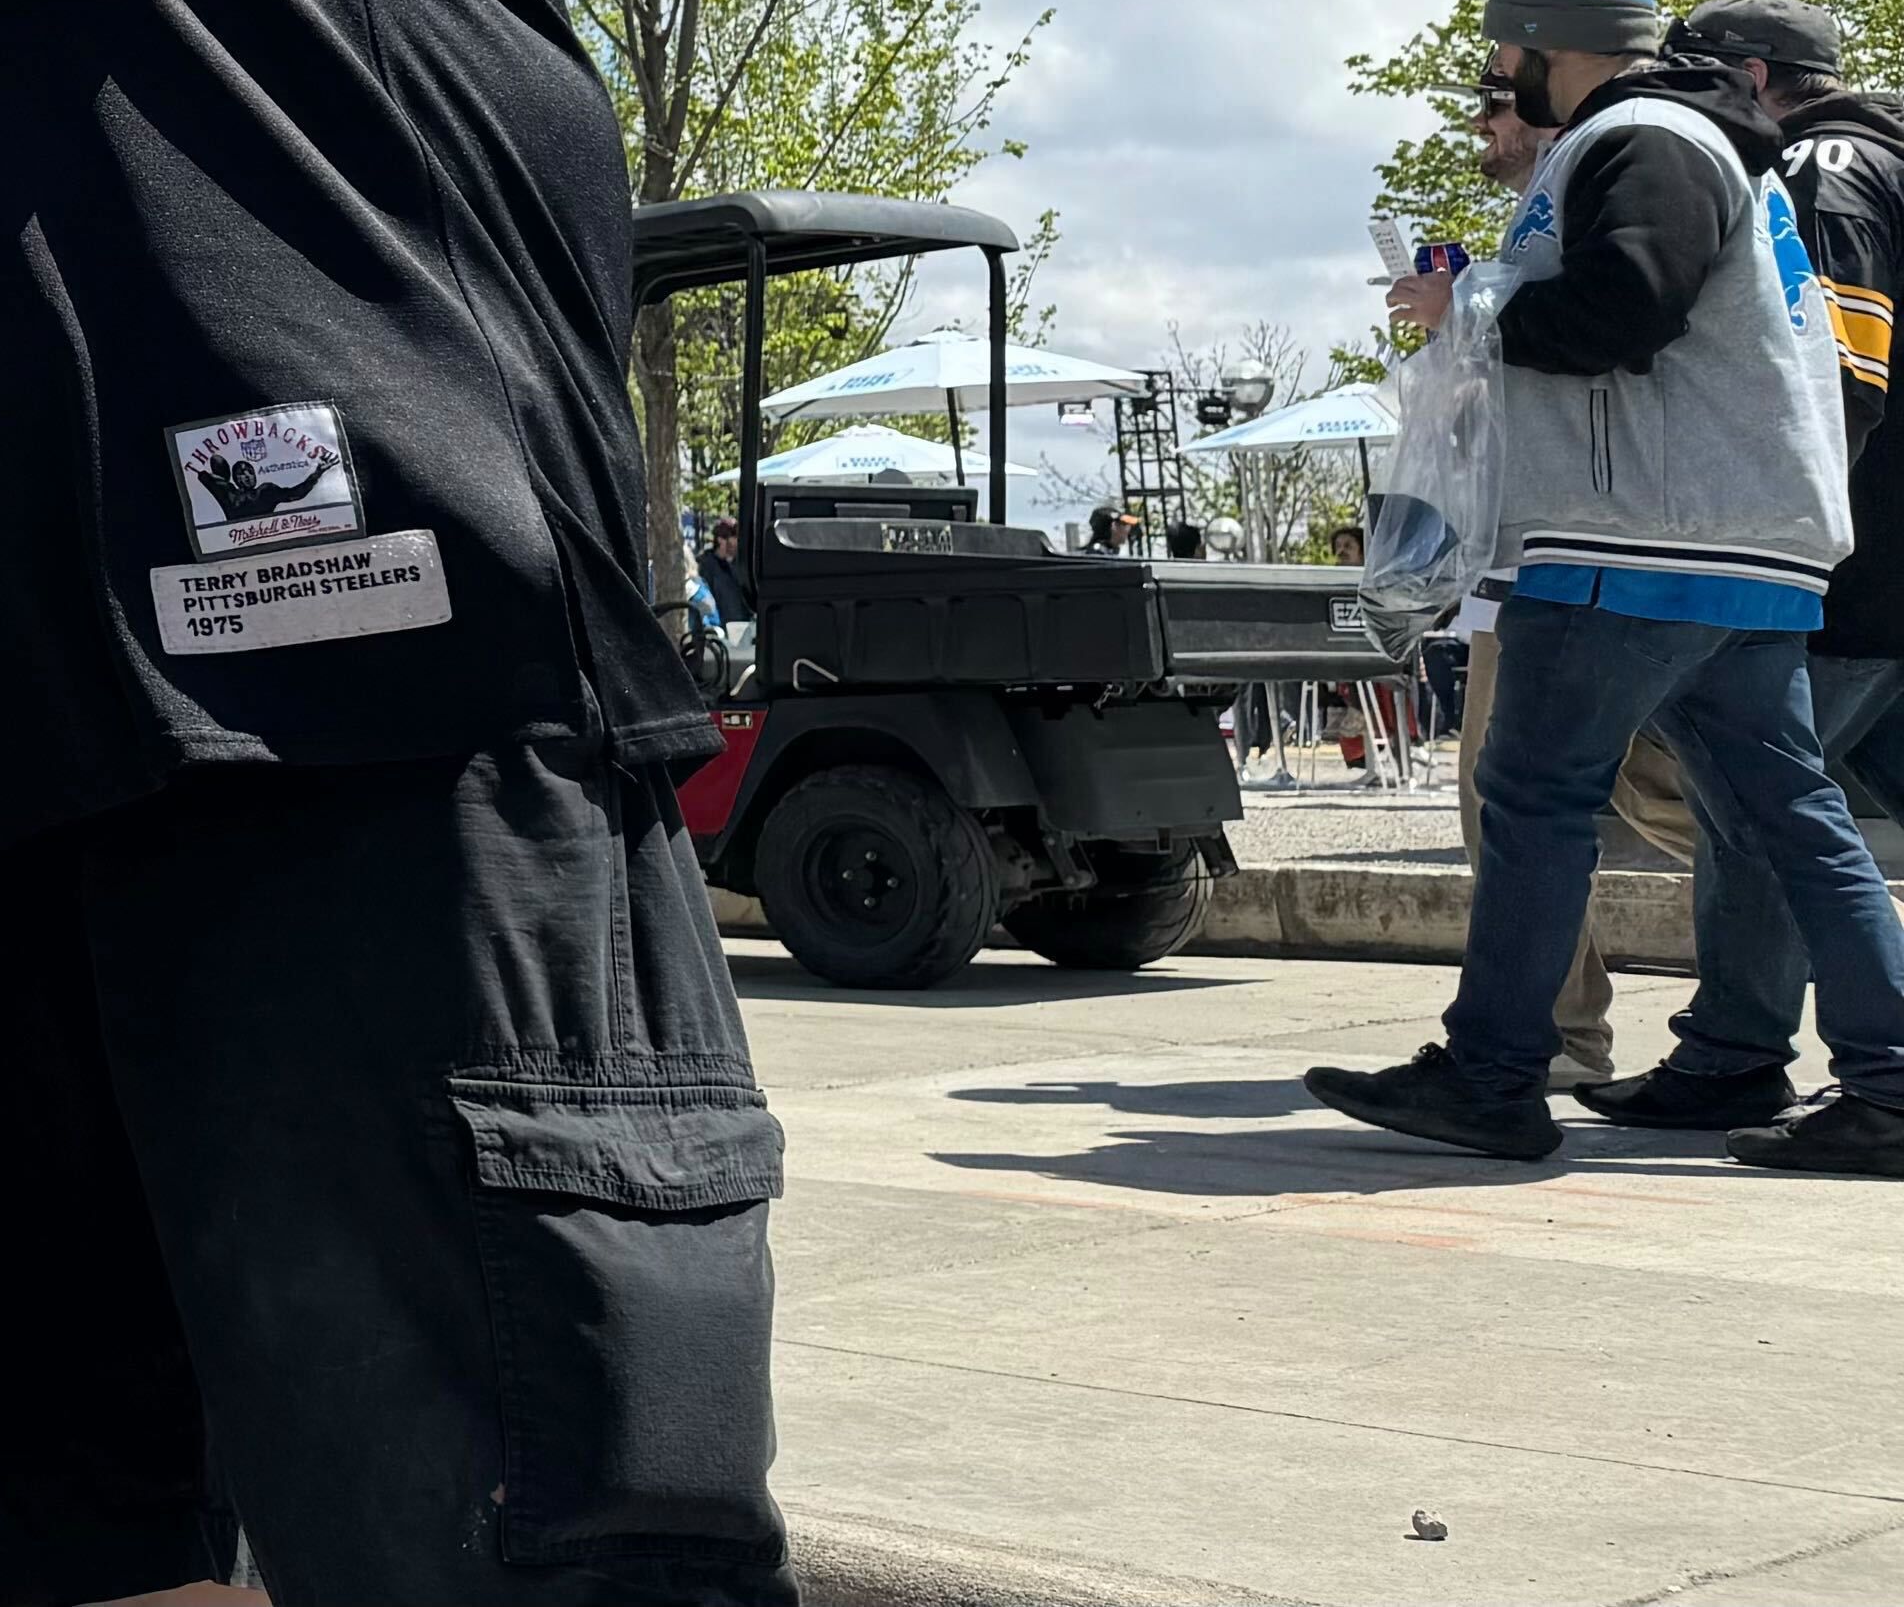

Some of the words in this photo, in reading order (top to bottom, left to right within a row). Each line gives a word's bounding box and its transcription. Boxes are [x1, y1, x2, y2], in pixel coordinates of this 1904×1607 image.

[1781, 138, 1855, 178] 90
[184, 420, 325, 474] THROWBACKS
[179, 571, 248, 593] TERRY
[257, 551, 372, 584] BRADSHAW
[183, 581, 316, 613] PITTSBURGH
[320, 565, 421, 595] STEELERS
[186, 614, 244, 637] 1975
